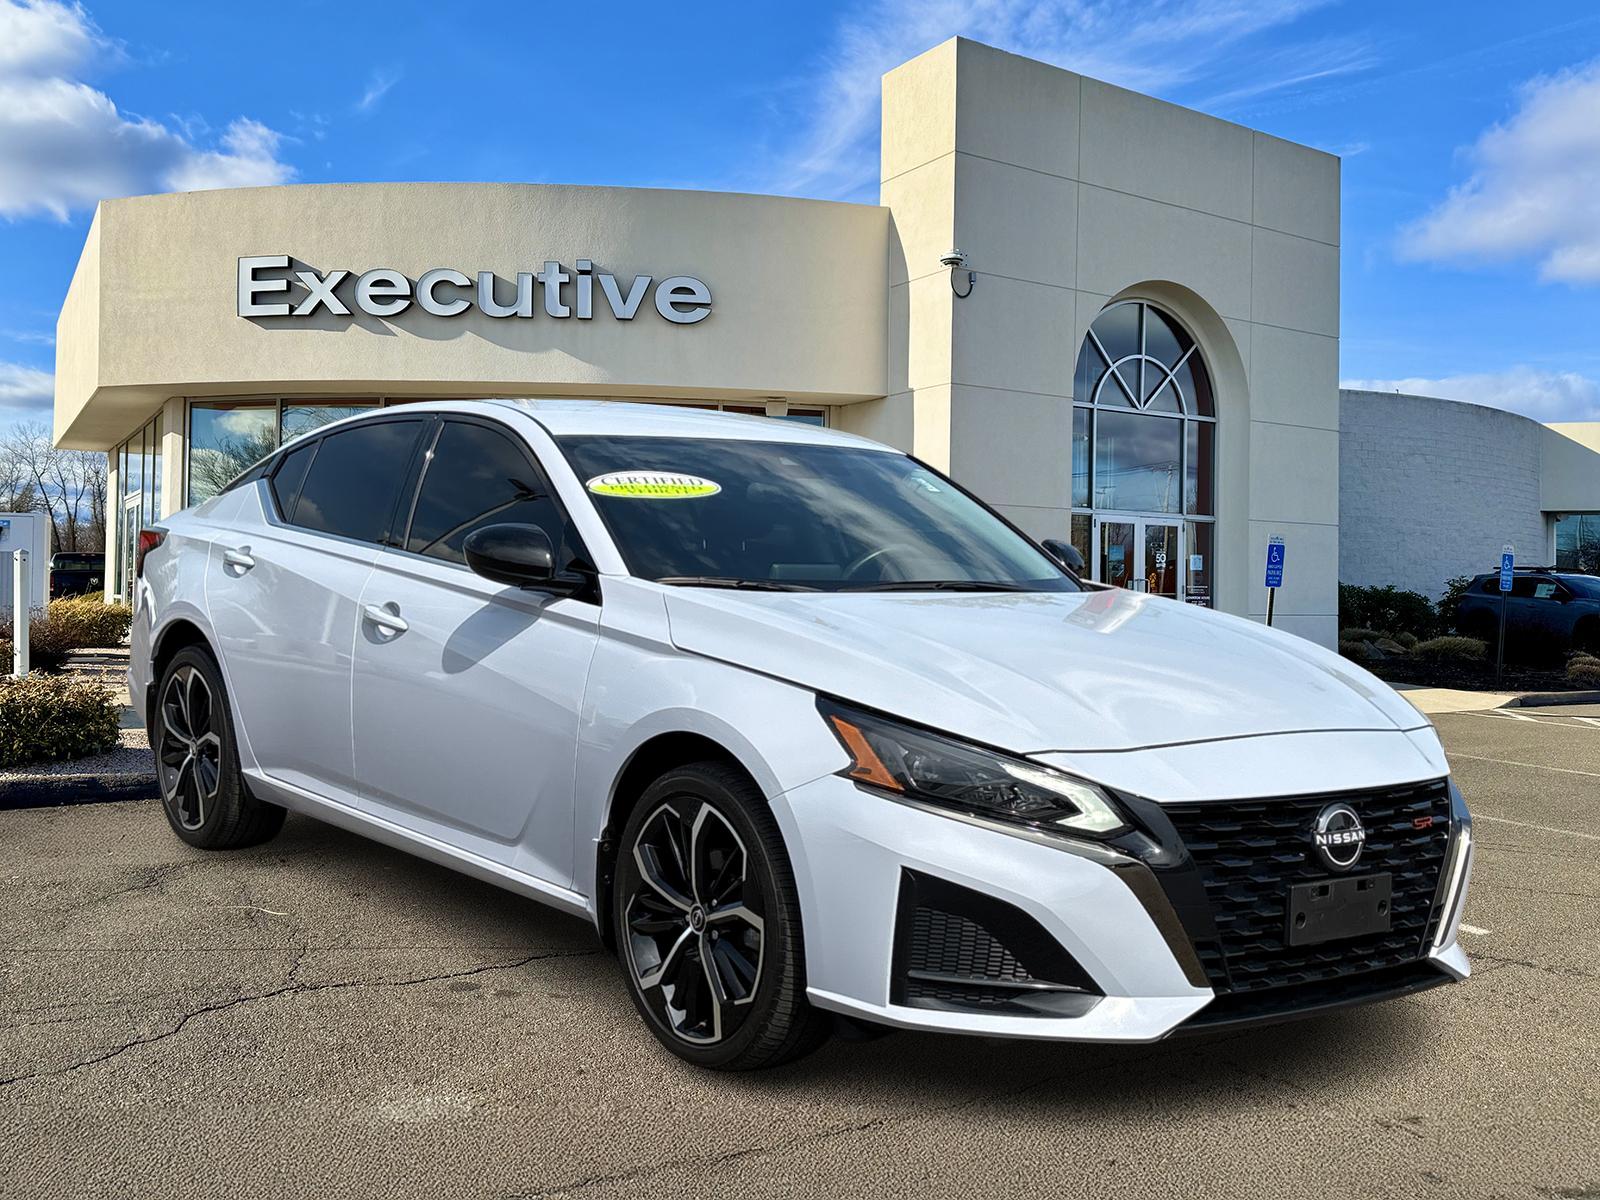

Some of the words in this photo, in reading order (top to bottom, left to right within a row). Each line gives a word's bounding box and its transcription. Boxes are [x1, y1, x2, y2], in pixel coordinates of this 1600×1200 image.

[237, 255, 713, 324] Executive
[601, 476, 703, 486] CERTIFIED
[1412, 816, 1433, 830] SR
[1316, 829, 1366, 845] NISSAN
